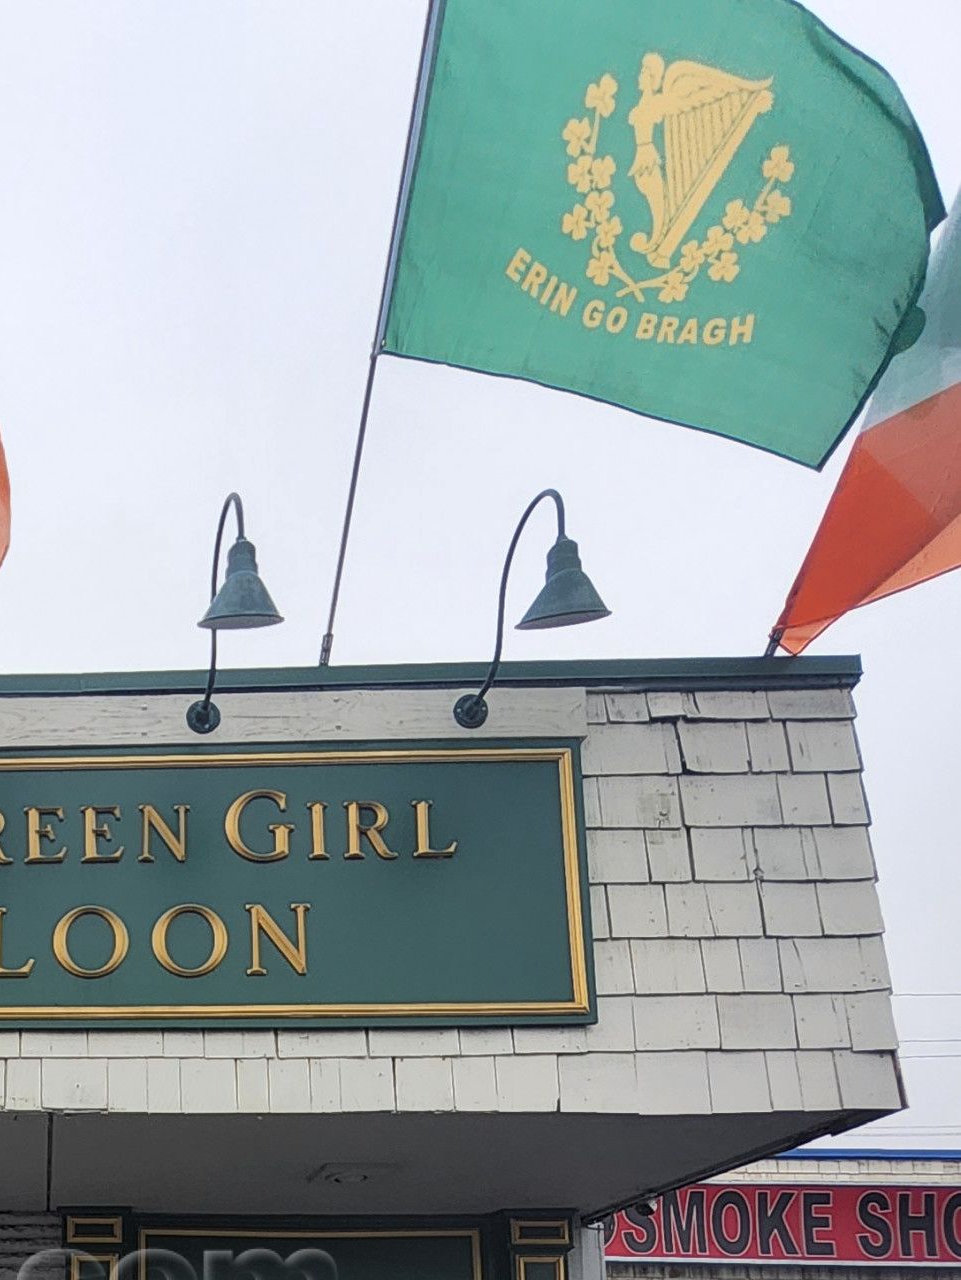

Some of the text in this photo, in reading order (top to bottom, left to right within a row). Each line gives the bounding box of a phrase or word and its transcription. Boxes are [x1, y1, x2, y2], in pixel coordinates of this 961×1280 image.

[505, 247, 756, 347] ERIN GO BRAGH
[224, 787, 458, 863] GIRL
[621, 1188, 837, 1258] SMOKE
